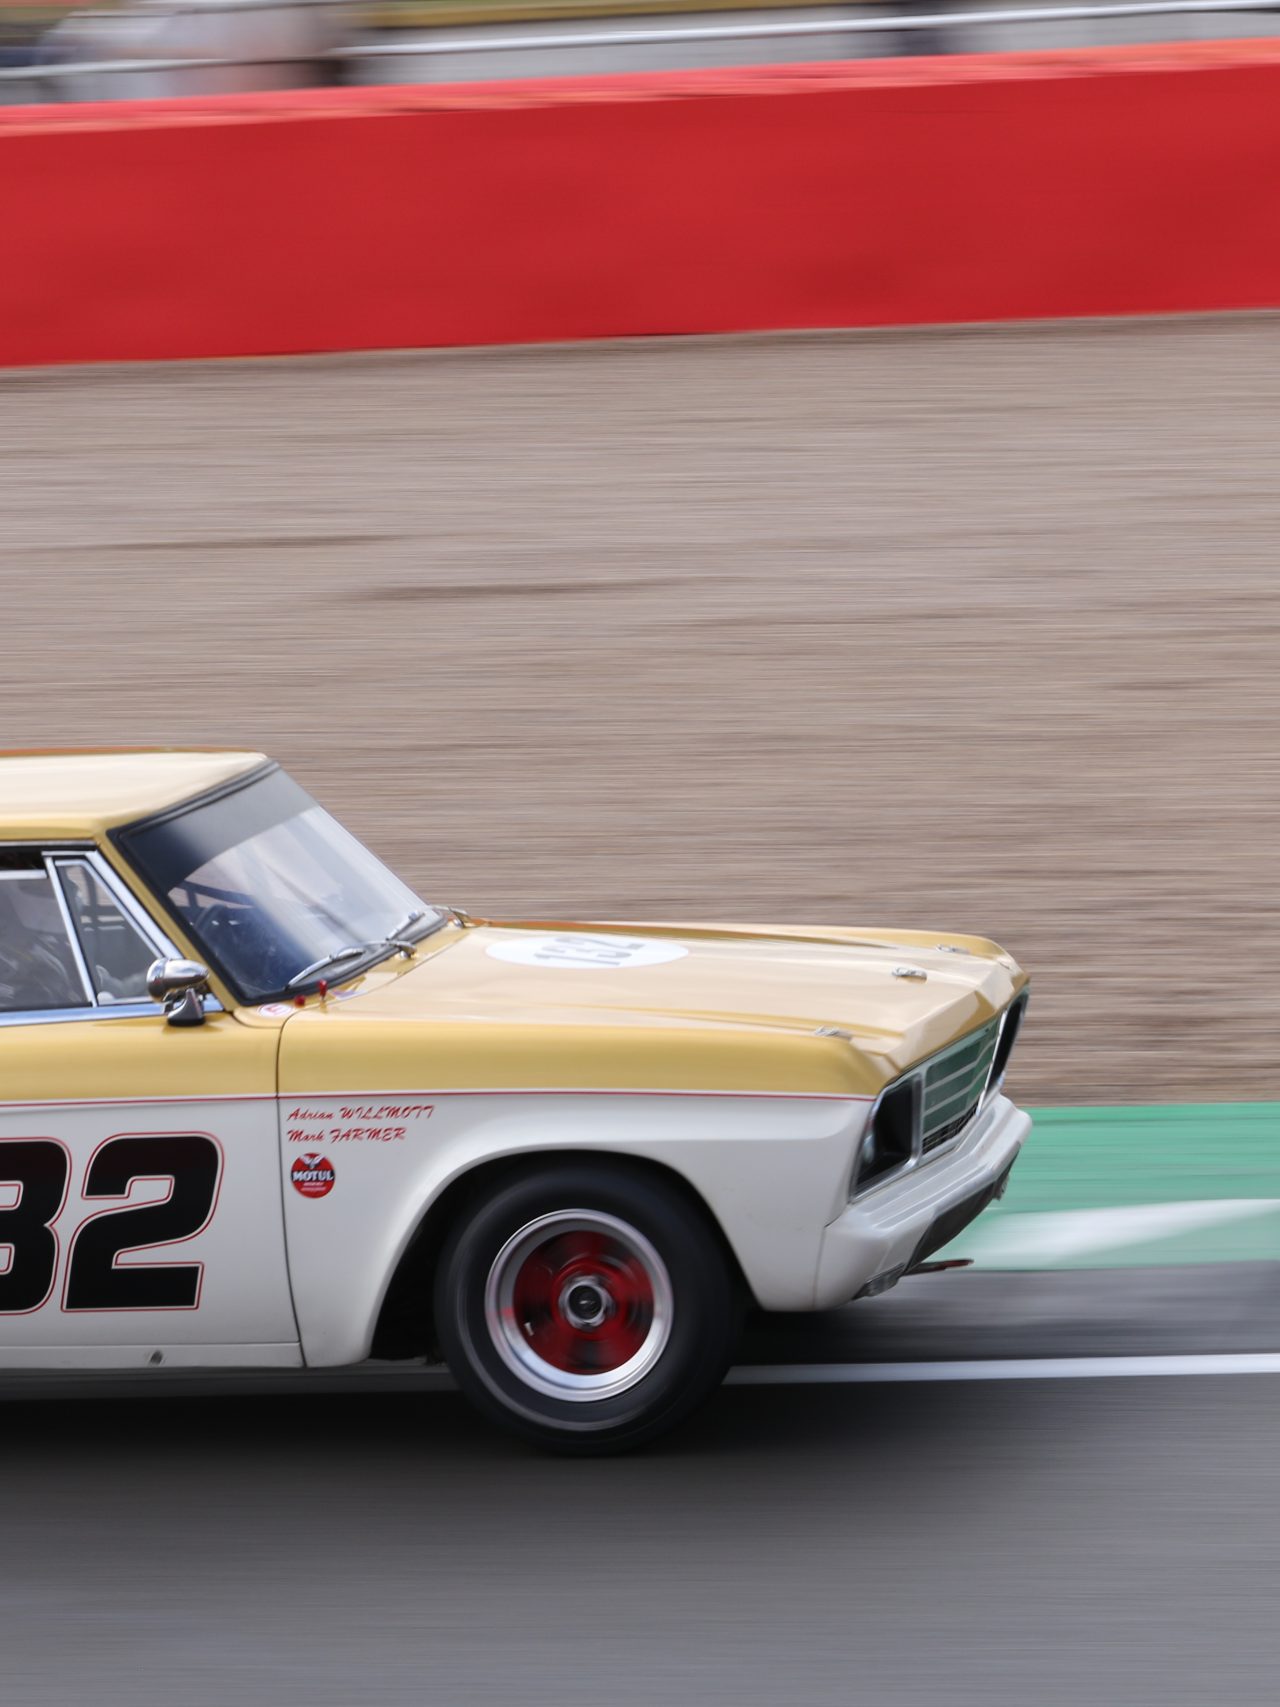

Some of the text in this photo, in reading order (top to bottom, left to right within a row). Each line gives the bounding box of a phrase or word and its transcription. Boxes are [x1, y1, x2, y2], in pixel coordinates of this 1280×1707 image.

[533, 936, 646, 966] 132
[287, 1104, 435, 1121] Adrian WILLMOTT
[287, 1127, 408, 1143] Mark FARMER
[292, 1169, 334, 1182] MOTUL
